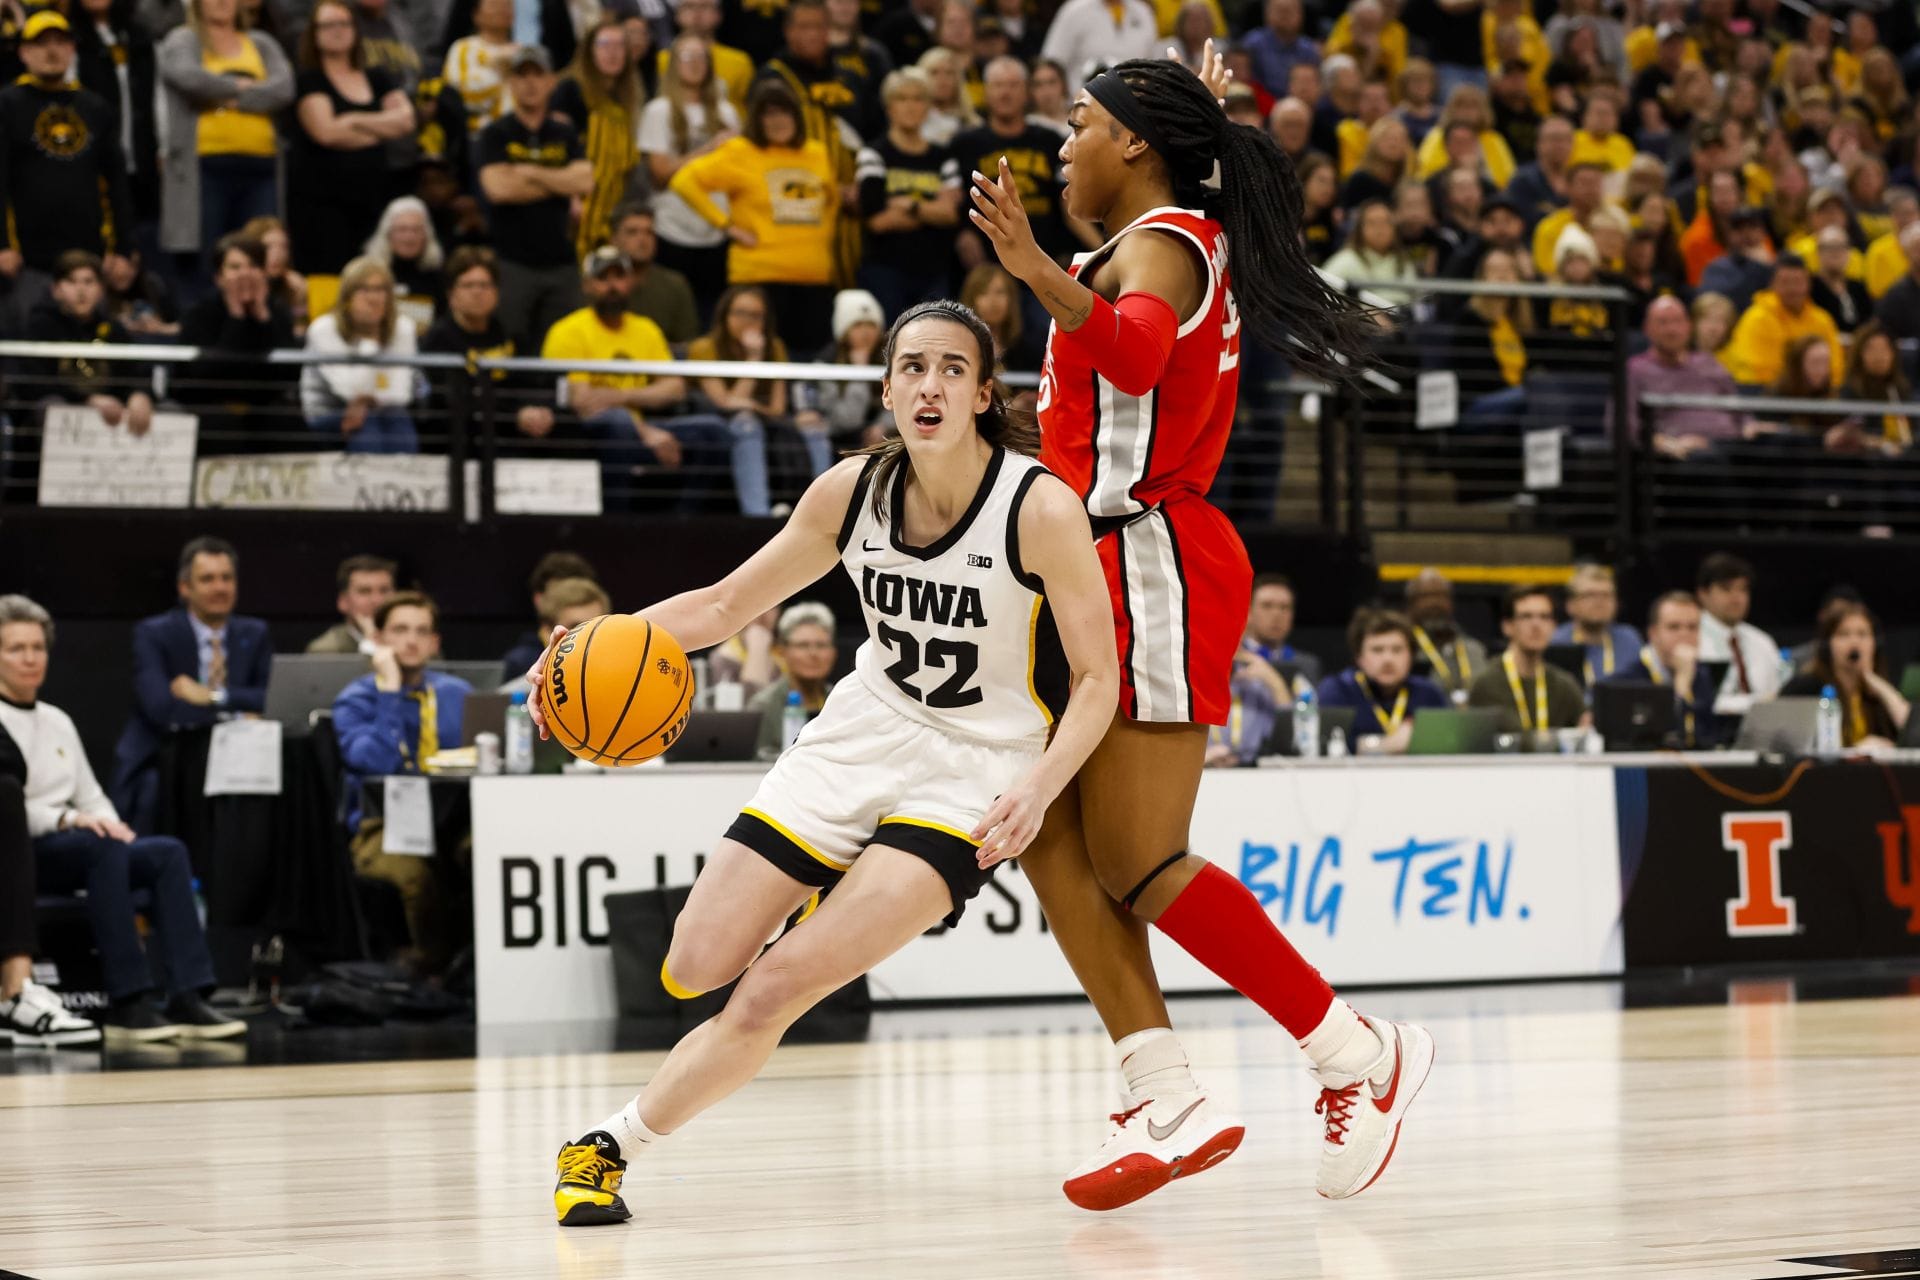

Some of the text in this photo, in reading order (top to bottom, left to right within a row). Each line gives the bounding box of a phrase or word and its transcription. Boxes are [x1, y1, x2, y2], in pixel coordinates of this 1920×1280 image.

[202, 459, 320, 505] CARVE
[863, 565, 988, 628] IOWA
[877, 620, 983, 708] 22
[502, 855, 616, 948] BIG
[1239, 836, 1530, 936] BIG TEN.
